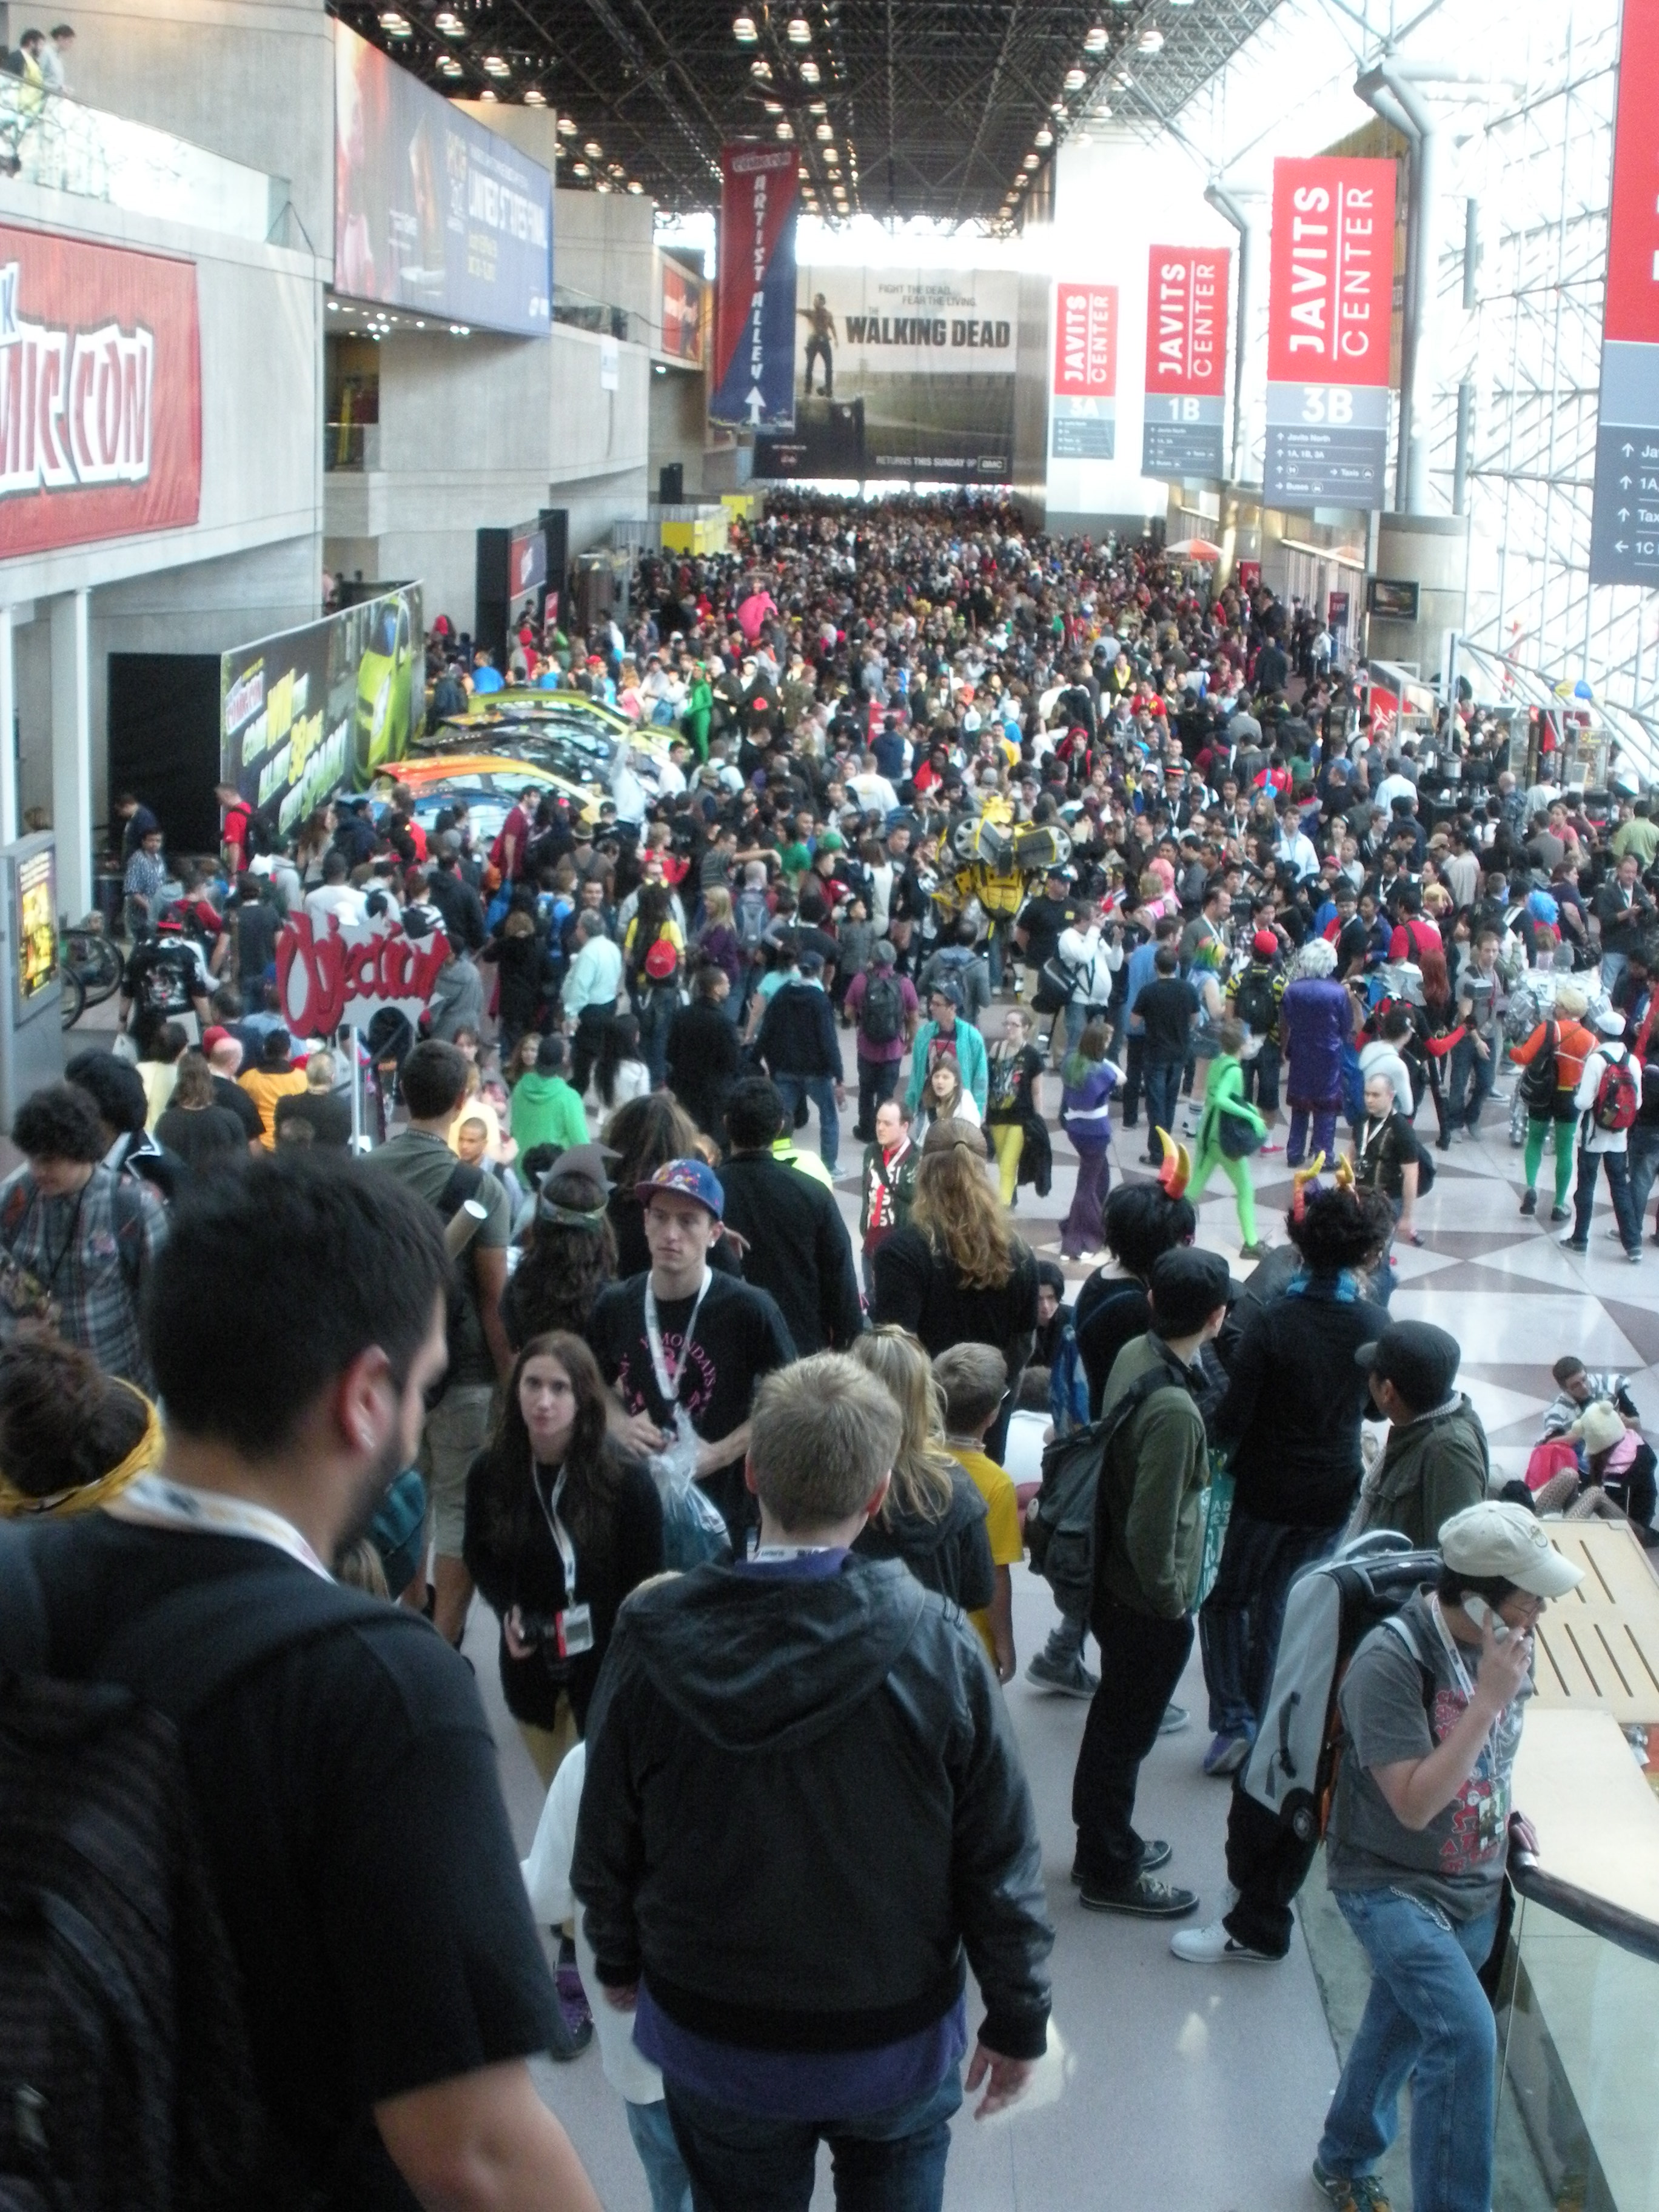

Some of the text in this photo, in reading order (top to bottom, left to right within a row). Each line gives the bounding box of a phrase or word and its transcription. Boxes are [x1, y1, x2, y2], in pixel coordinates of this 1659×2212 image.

[751, 174, 768, 380] ARTIST ALLEY
[1289, 187, 1330, 354] JAVITS
[1341, 188, 1373, 357] CENTER
[879, 284, 903, 294] FIGHT
[908, 284, 921, 295] THE
[902, 295, 926, 305] FEAR
[928, 296, 943, 306] THE
[846, 315, 1011, 348] WALKING DEAD
[1158, 263, 1186, 376] JAVITS
[1193, 264, 1215, 377] CENTER
[1064, 295, 1087, 382] JAVITS
[1091, 295, 1109, 383] CENTER
[1070, 397, 1099, 417] 3A
[1168, 397, 1200, 421] 1B
[1302, 387, 1353, 423] 3B
[1287, 434, 1331, 443] Javits North
[876, 455, 911, 466] RETURNS
[914, 456, 932, 466] THIS
[933, 457, 965, 468] SUNDAY
[1636, 541, 1654, 555] 1C
